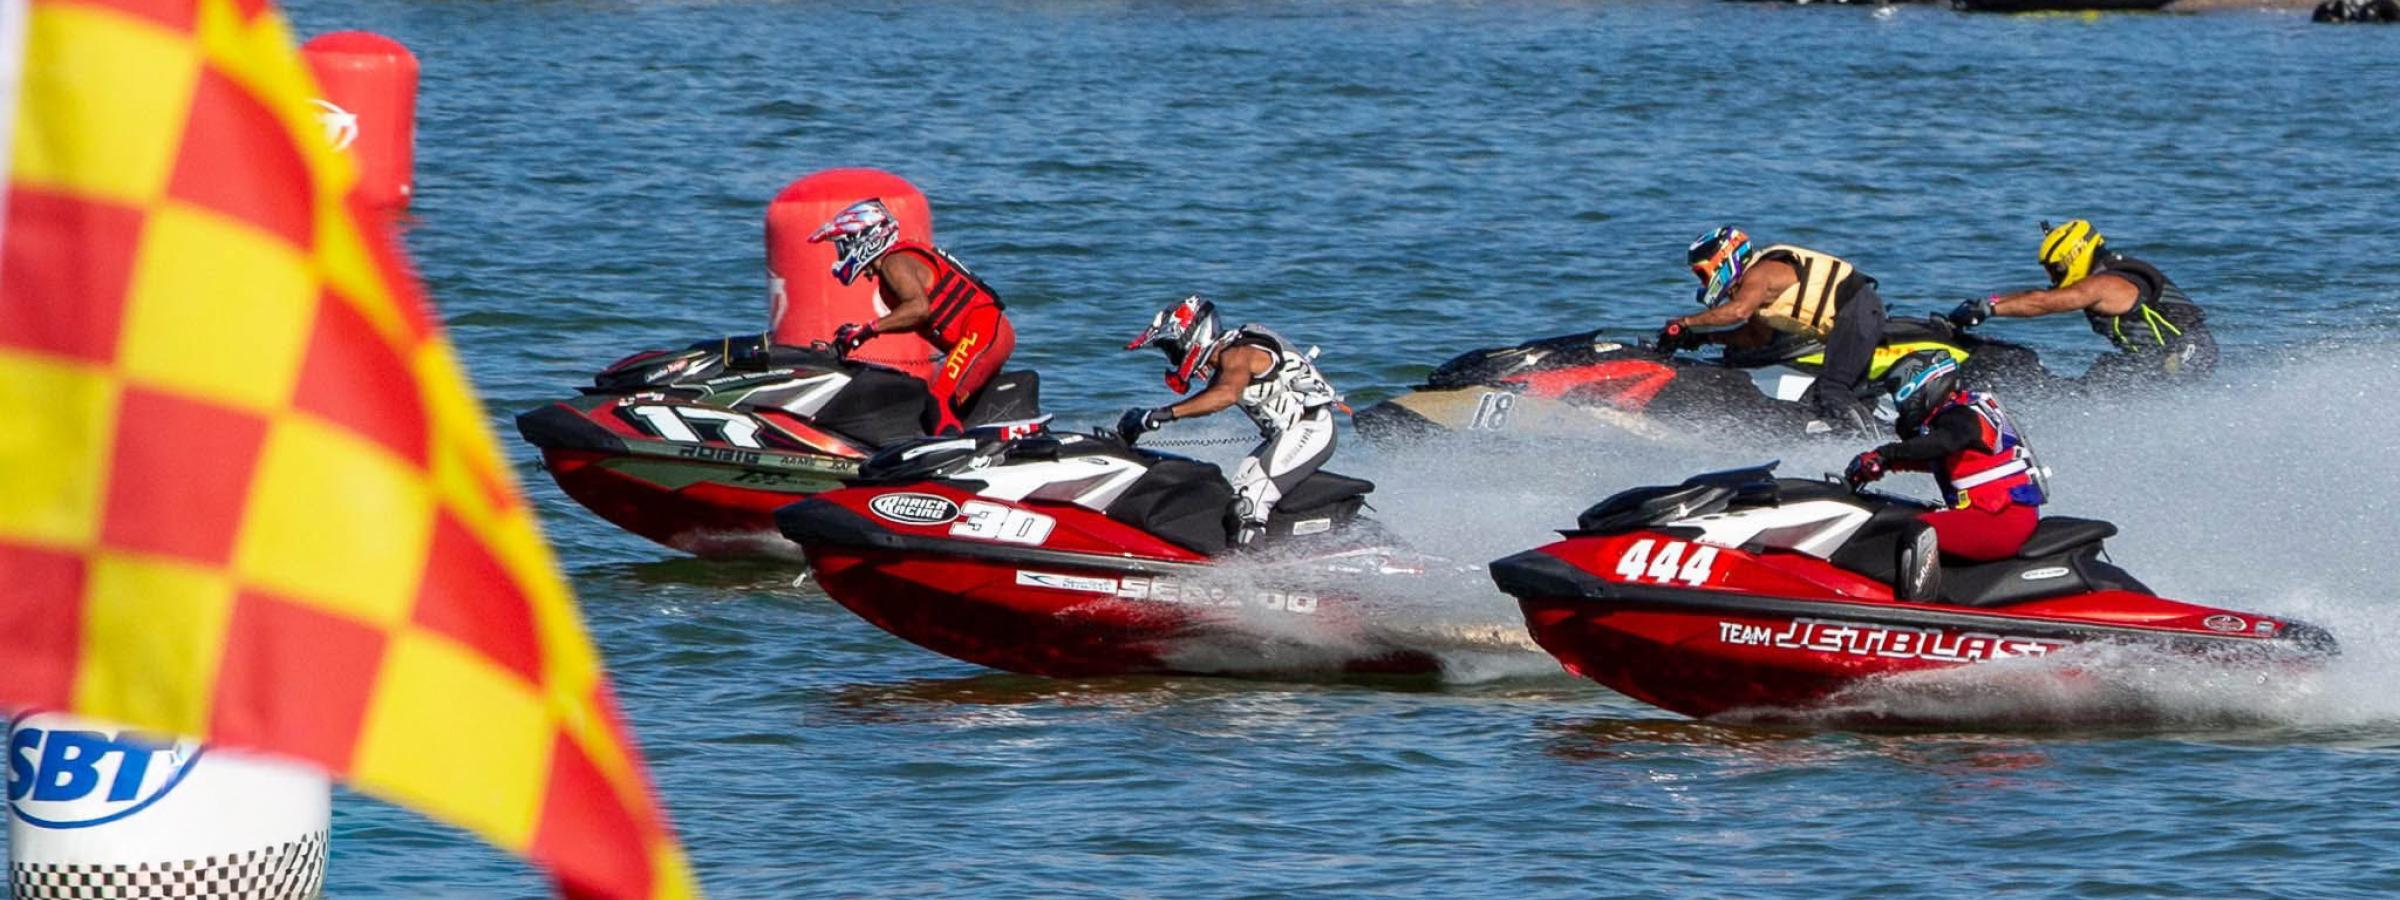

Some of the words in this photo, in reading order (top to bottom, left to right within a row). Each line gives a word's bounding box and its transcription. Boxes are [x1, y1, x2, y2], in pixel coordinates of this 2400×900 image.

[634, 405, 759, 449] 17
[1468, 392, 1515, 432] 18
[949, 500, 1057, 546] 30
[1616, 539, 1720, 586] 444
[1719, 622, 1772, 646] TEAM
[1775, 618, 2066, 664] JETBLAST
[9, 728, 177, 802] SBT
